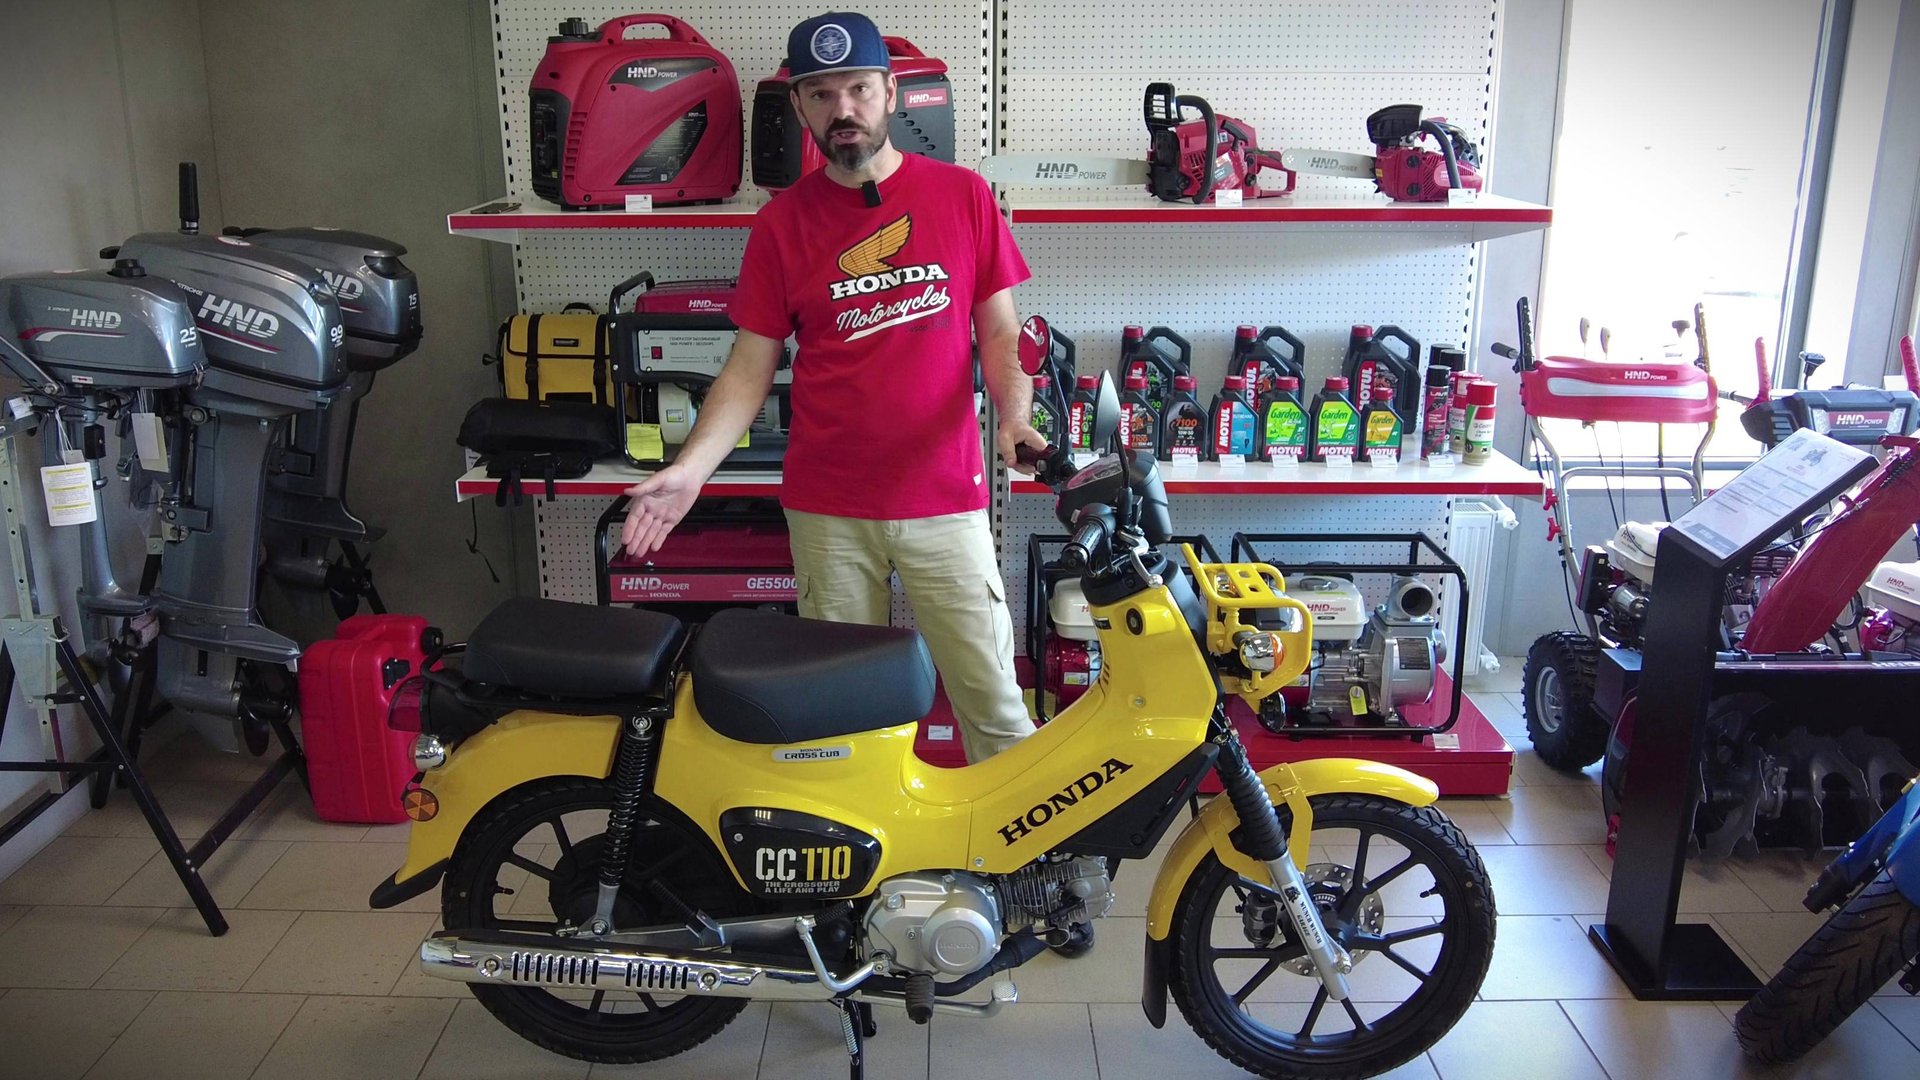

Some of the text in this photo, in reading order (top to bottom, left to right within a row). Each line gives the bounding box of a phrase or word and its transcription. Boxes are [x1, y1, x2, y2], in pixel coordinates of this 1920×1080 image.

[628, 67, 657, 78] HND
[908, 94, 929, 104] HND
[1310, 156, 1339, 169] HND
[1035, 163, 1079, 179] HND
[315, 268, 364, 300] ND
[829, 264, 948, 300] HONDA
[409, 293, 417, 306] 15
[688, 300, 711, 308] HND
[837, 284, 948, 332] Motorcycles
[70, 309, 122, 328] HND
[198, 294, 279, 338] HND
[1624, 371, 1650, 379] HND
[1271, 408, 1301, 420] Garden
[1321, 410, 1348, 419] Garden
[1371, 415, 1394, 424] Garden
[1836, 415, 1864, 424] HND
[1071, 407, 1081, 444] MOTUL
[1120, 408, 1130, 446] MOTUL
[1220, 408, 1230, 447] MOTUL
[1268, 446, 1302, 455] MOTUL
[1319, 446, 1354, 455] MOTUL
[621, 578, 661, 590] HND
[997, 758, 1134, 846] HONDA
[756, 846, 851, 881] CC 110
